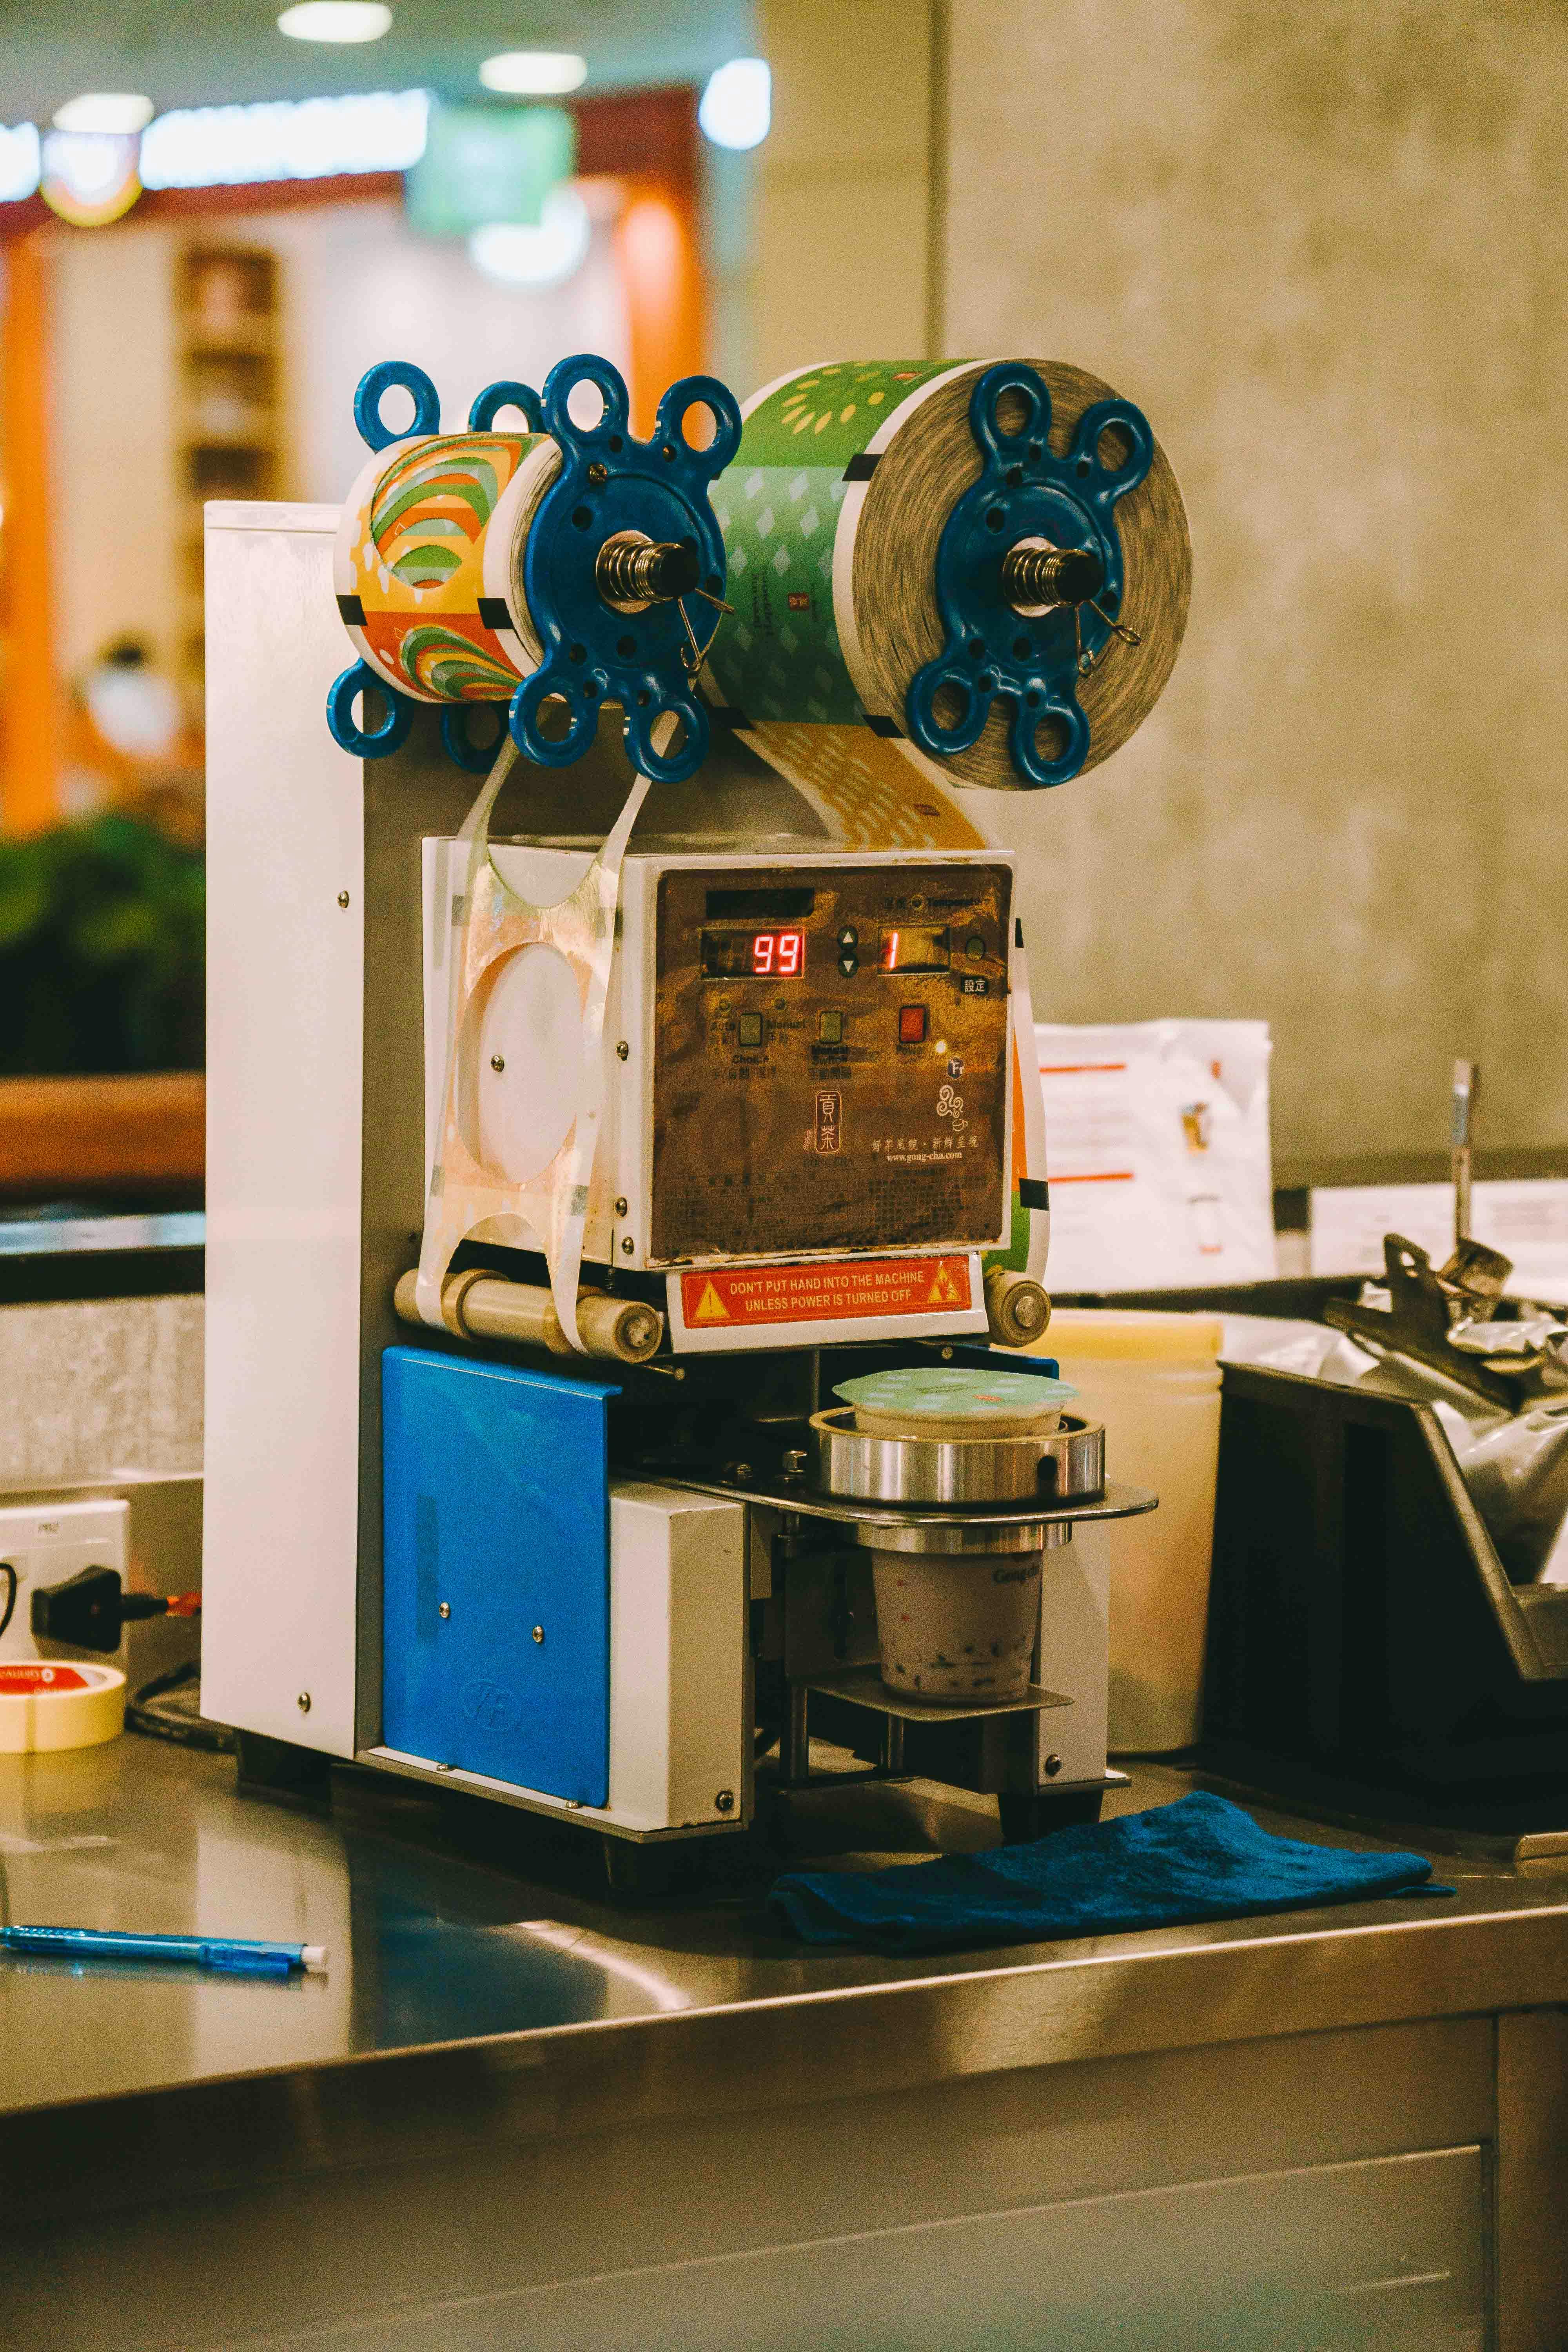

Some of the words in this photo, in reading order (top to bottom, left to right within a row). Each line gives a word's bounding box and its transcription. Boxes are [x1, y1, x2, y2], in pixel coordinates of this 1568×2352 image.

[755, 935, 799, 973] 99
[889, 932, 898, 968] 1
[964, 978, 985, 993] 設定
[767, 1019, 806, 1029] Manual
[733, 1054, 769, 1064] Choice
[819, 1094, 837, 1150] 貢茶
[887, 1151, 962, 1163] www.gong-cha.com
[730, 1281, 763, 1294] DON'T
[766, 1280, 787, 1292] PUT
[790, 1278, 821, 1291] HAND
[824, 1276, 849, 1289] INTO
[852, 1274, 873, 1287] THE
[875, 1271, 925, 1285] MACHINE
[746, 1297, 788, 1312] UNLESS
[791, 1295, 830, 1308] POWER
[833, 1294, 842, 1305] IS
[846, 1291, 889, 1305] TURNED
[891, 1289, 911, 1301] OFF
